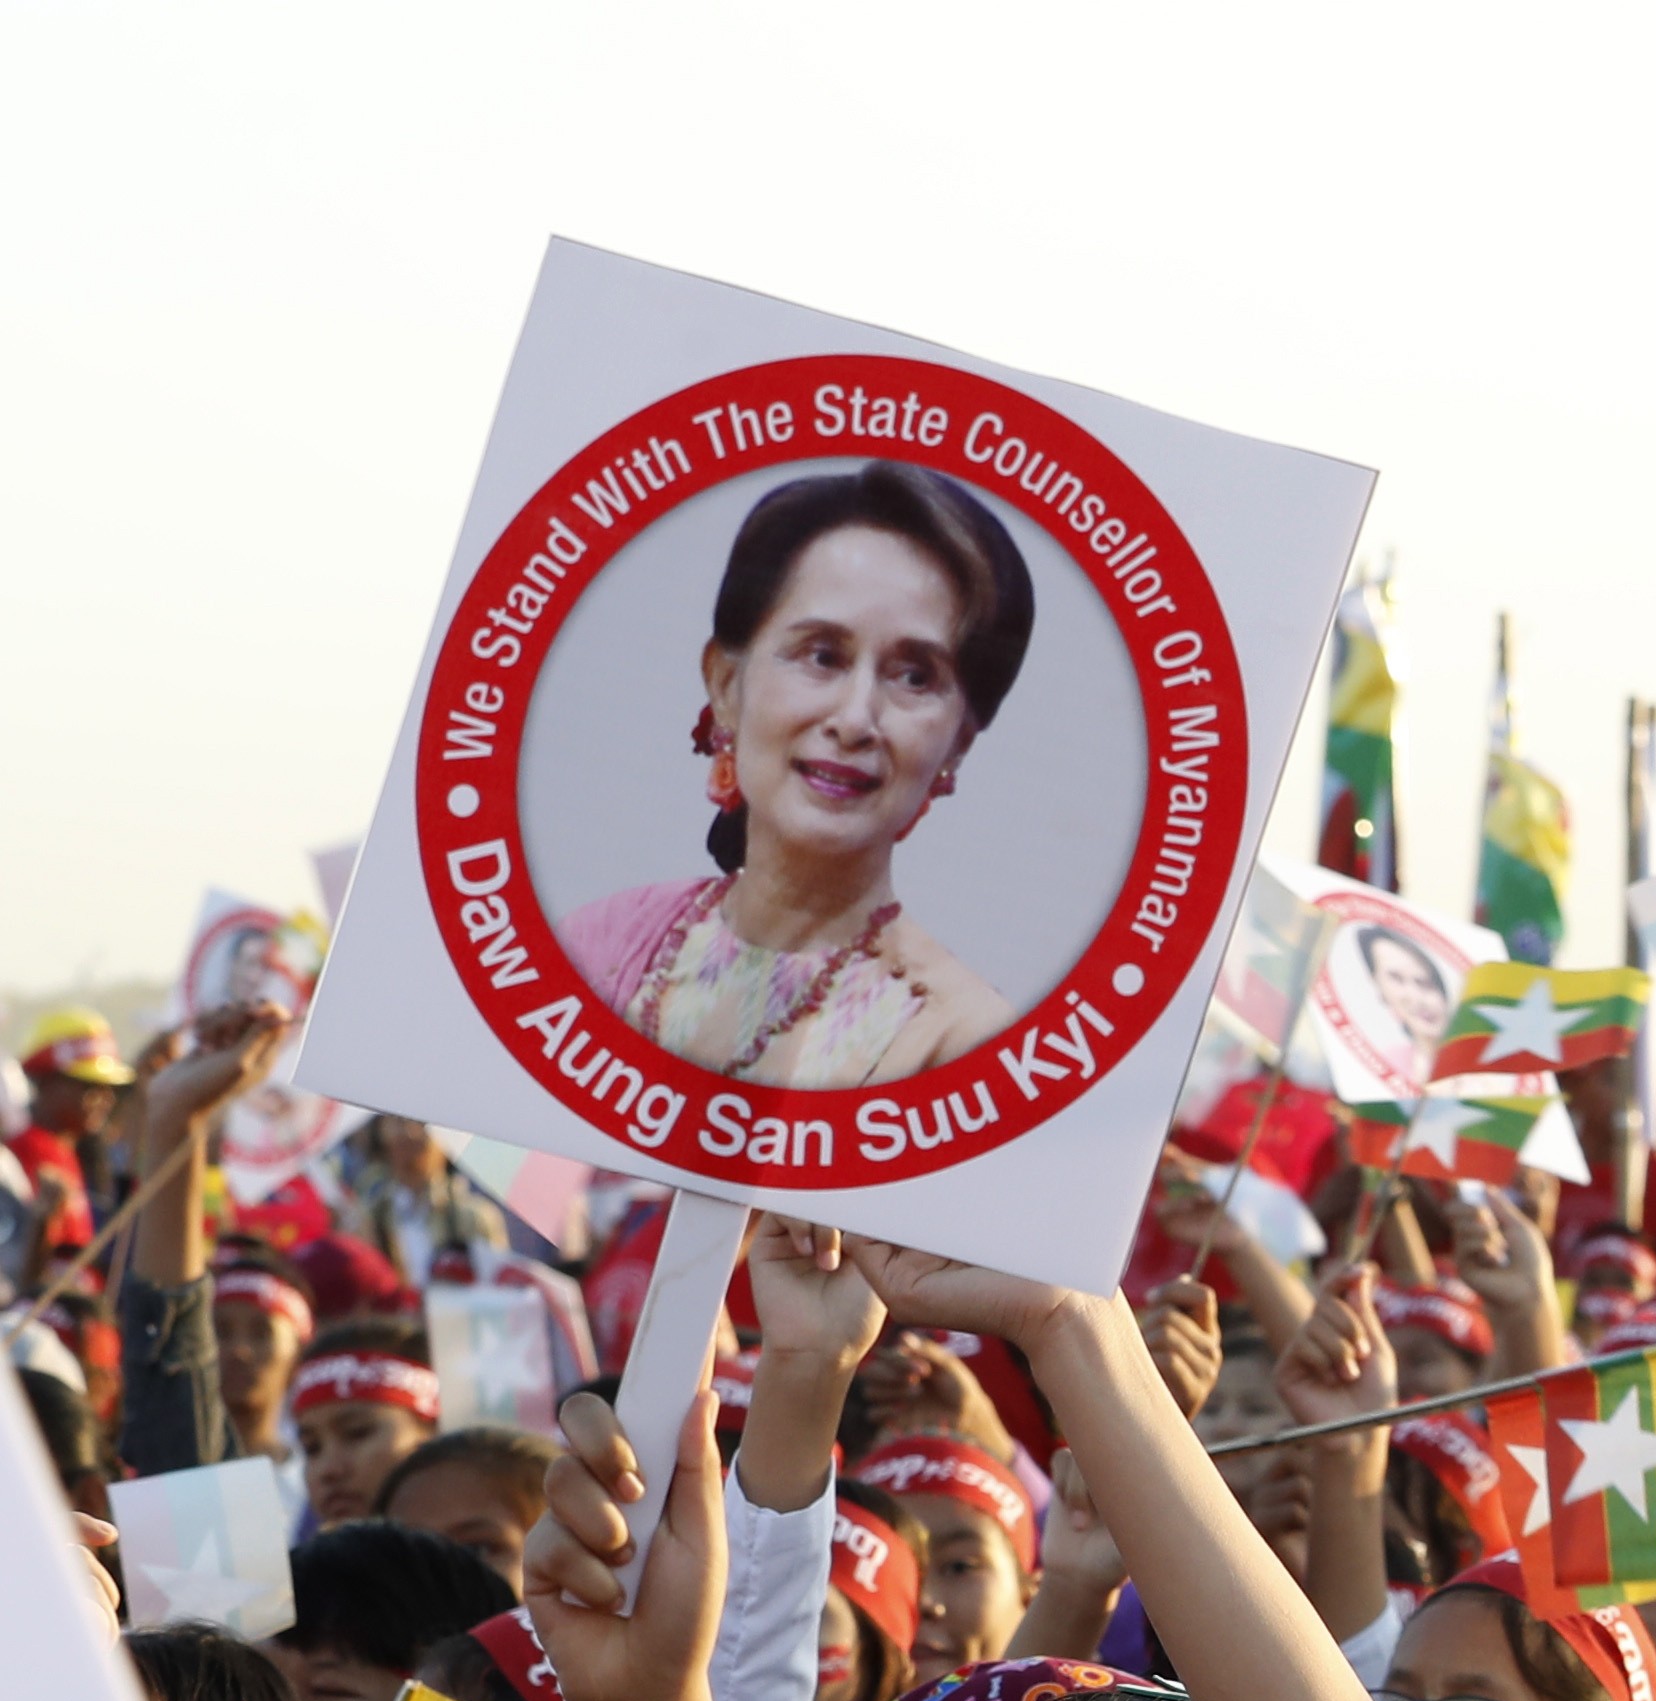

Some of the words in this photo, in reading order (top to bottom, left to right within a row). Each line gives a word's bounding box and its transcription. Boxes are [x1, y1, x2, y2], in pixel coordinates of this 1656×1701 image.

[692, 397, 794, 459] The
[814, 384, 948, 447] State
[571, 437, 691, 528] With
[964, 412, 1177, 618] Counsellor
[472, 518, 588, 668] Stand
[1153, 630, 1211, 688] Of
[444, 683, 504, 762] We
[1131, 705, 1220, 954] Myanmar
[447, 838, 539, 989] Daw
[516, 995, 686, 1148] Aung
[699, 1093, 833, 1166] San
[856, 1080, 999, 1162] Suu
[998, 991, 1114, 1101] Kyi
